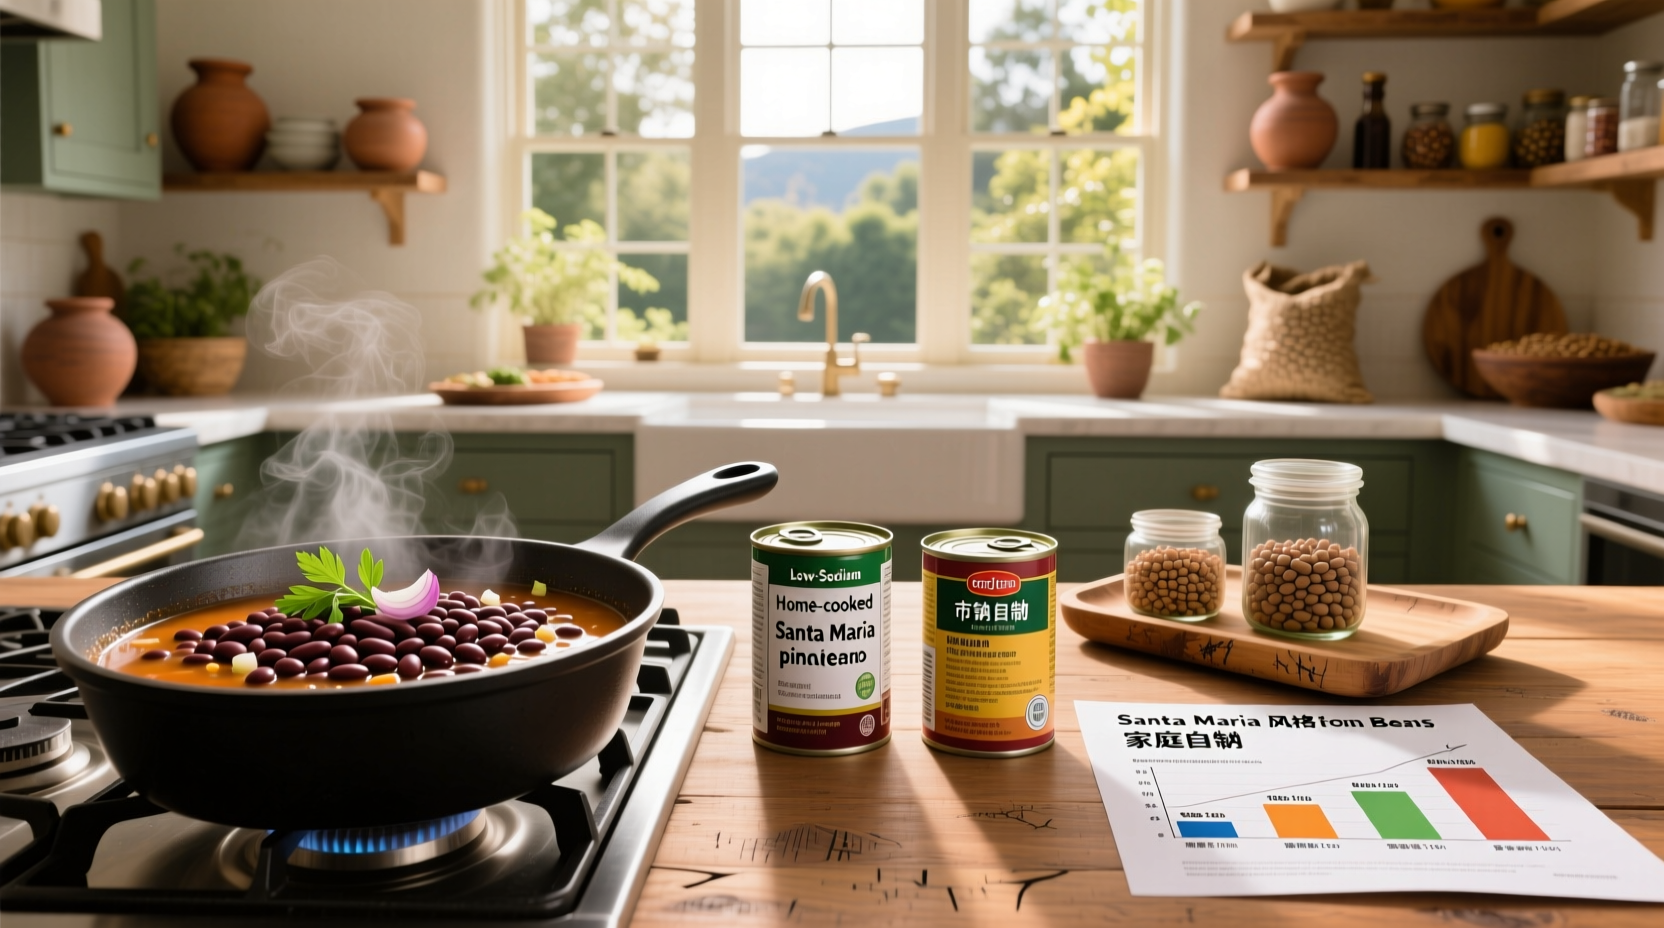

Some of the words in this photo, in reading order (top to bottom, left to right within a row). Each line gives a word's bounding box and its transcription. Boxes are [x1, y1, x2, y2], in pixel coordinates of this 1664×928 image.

[775, 592, 873, 613] Home-cooked
[775, 620, 825, 643] Santa
[829, 620, 875, 642] Maria
[1117, 714, 1186, 726] Santa
[1193, 714, 1261, 727] Maria
